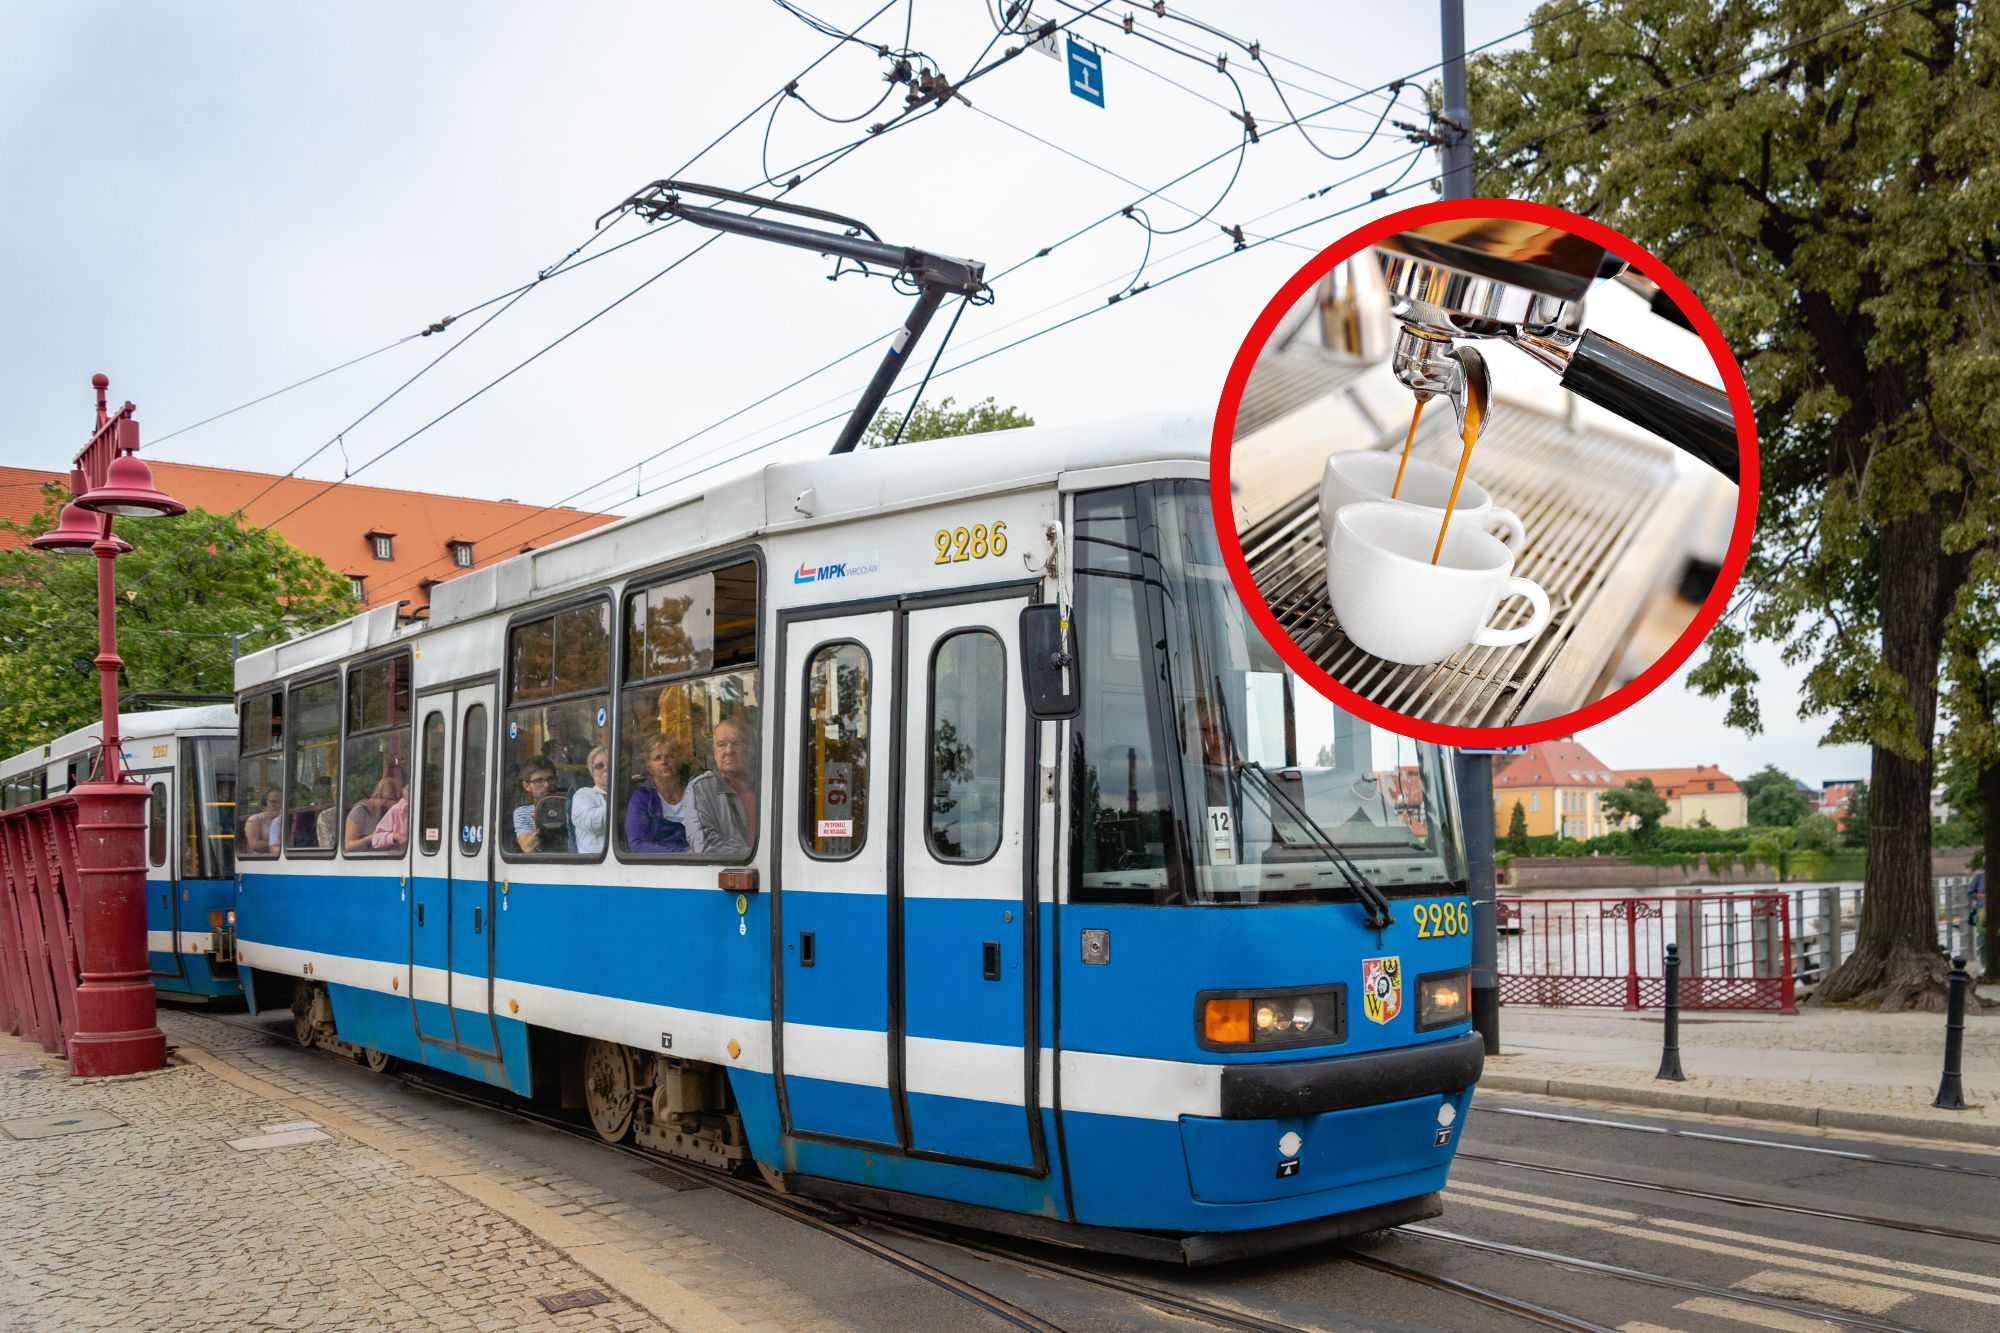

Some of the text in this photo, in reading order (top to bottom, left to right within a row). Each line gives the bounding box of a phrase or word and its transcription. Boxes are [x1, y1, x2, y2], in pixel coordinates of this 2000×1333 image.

[934, 520, 1008, 565] 2286
[817, 561, 847, 581] MPK
[1211, 812, 1229, 831] 12
[1413, 901, 1469, 940] 2286
